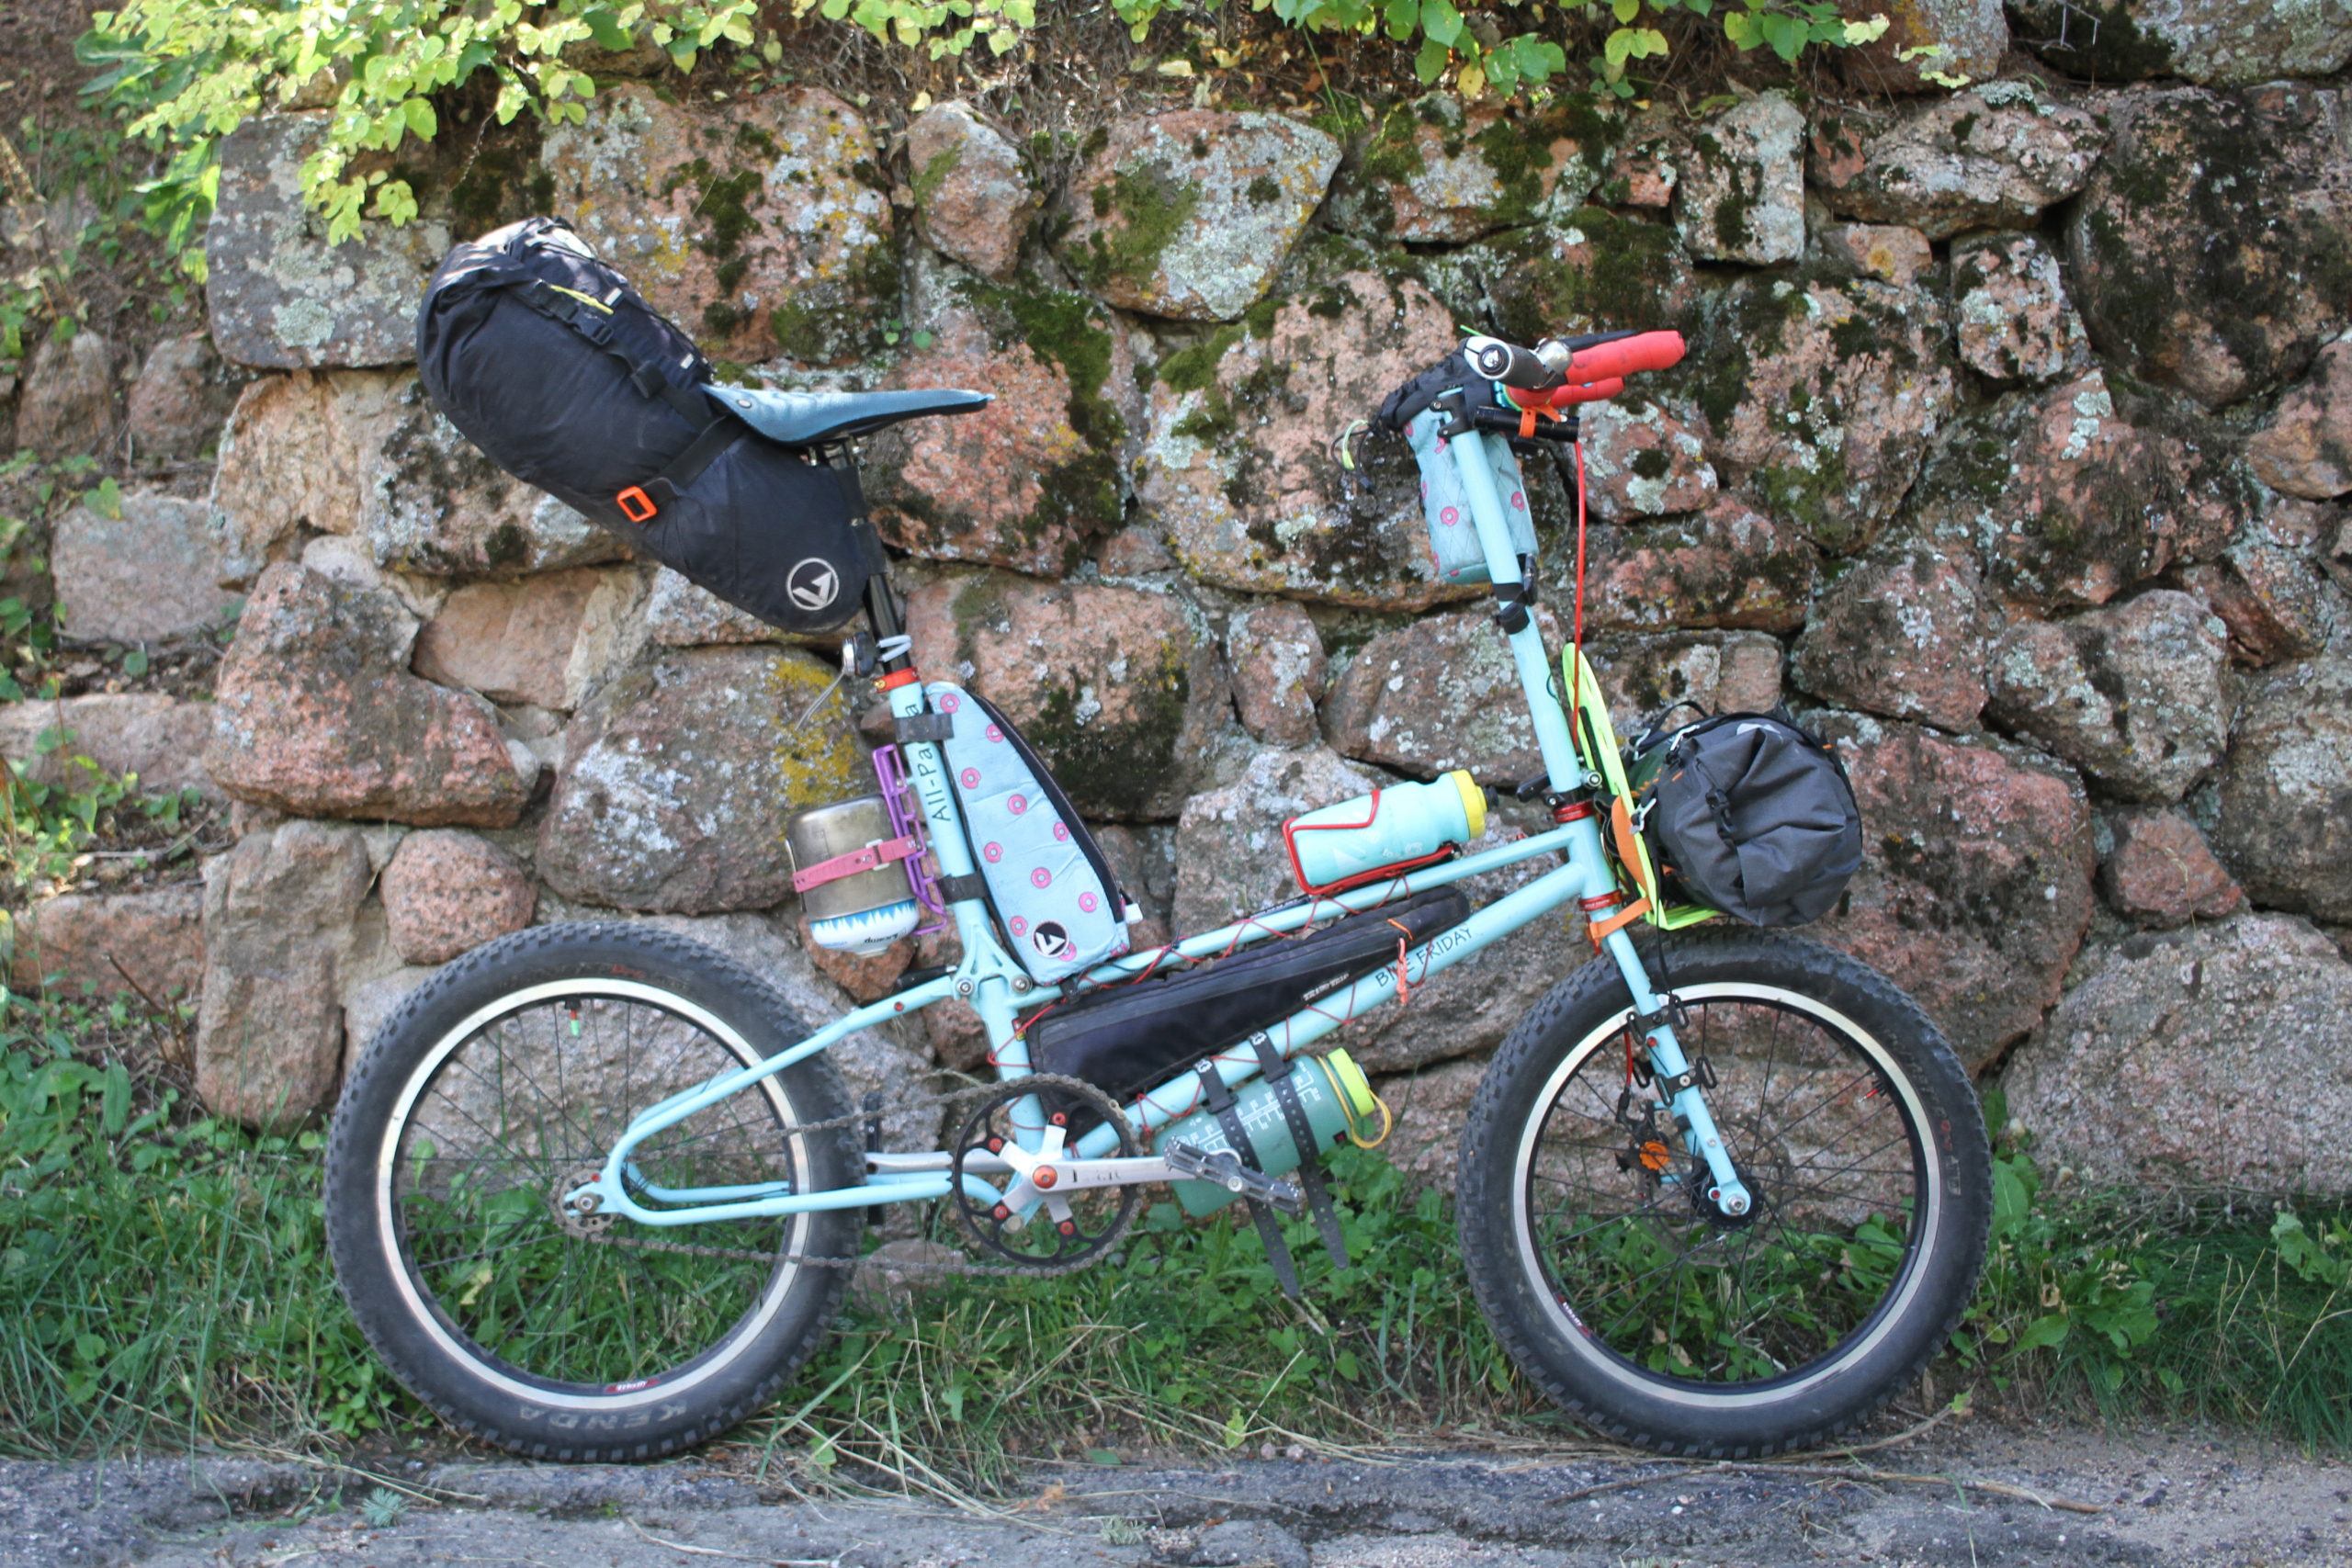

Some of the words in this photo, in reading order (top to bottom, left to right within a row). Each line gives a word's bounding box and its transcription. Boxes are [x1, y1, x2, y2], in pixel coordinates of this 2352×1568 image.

[904, 703, 952, 822] All-Paa
[1375, 956, 1415, 987] BIE
[1416, 927, 1473, 965] FRIDAY
[520, 1399, 687, 1430] KENDA
